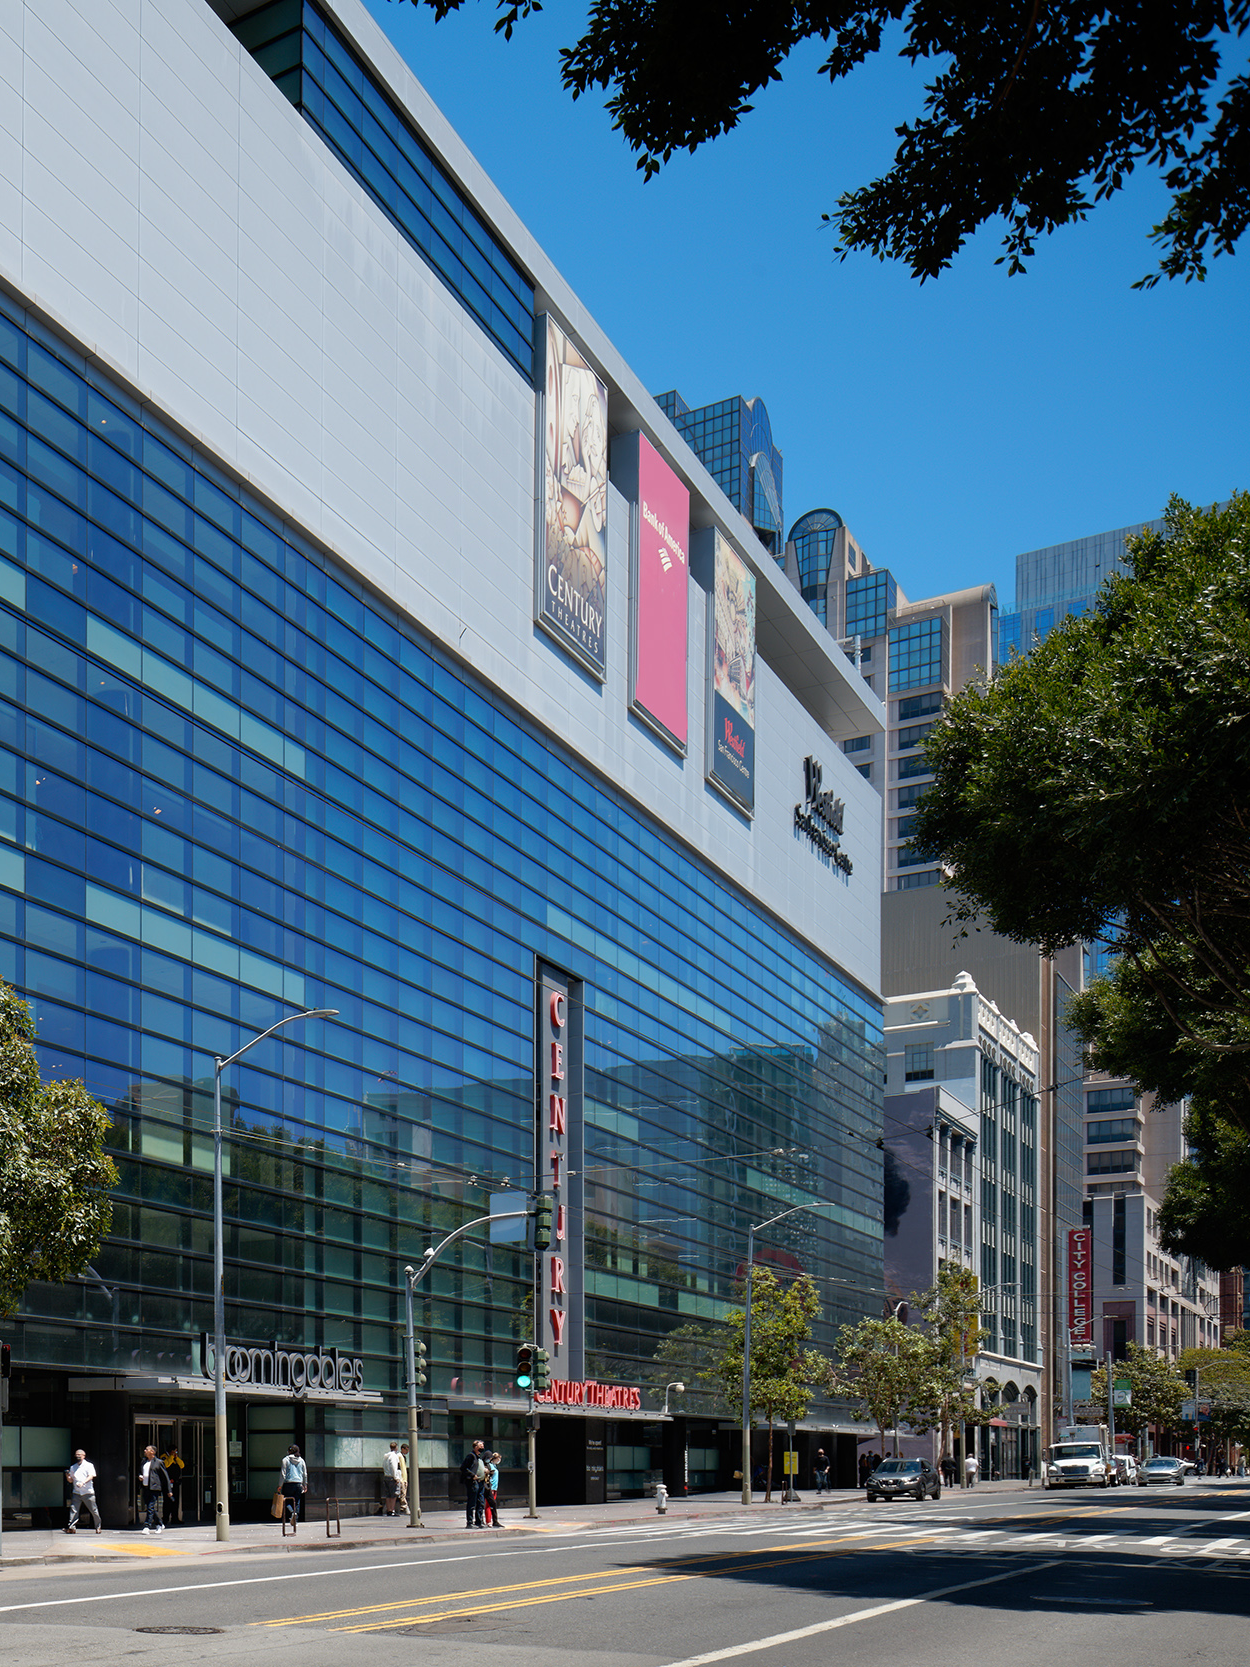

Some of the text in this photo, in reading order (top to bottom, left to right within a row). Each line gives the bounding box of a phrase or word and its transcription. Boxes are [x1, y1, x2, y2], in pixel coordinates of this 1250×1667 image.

[643, 500, 658, 532] Bank
[664, 525, 685, 565] America
[548, 564, 602, 638] CENTURY
[551, 601, 598, 653] THEATRES
[724, 717, 746, 758] Westfield
[804, 755, 845, 835] Westfield
[550, 991, 567, 1345] CENTURY
[1073, 1233, 1086, 1268] CITY
[1073, 1272, 1086, 1335] COLLEGE
[586, 1380, 641, 1411] THEATRES
